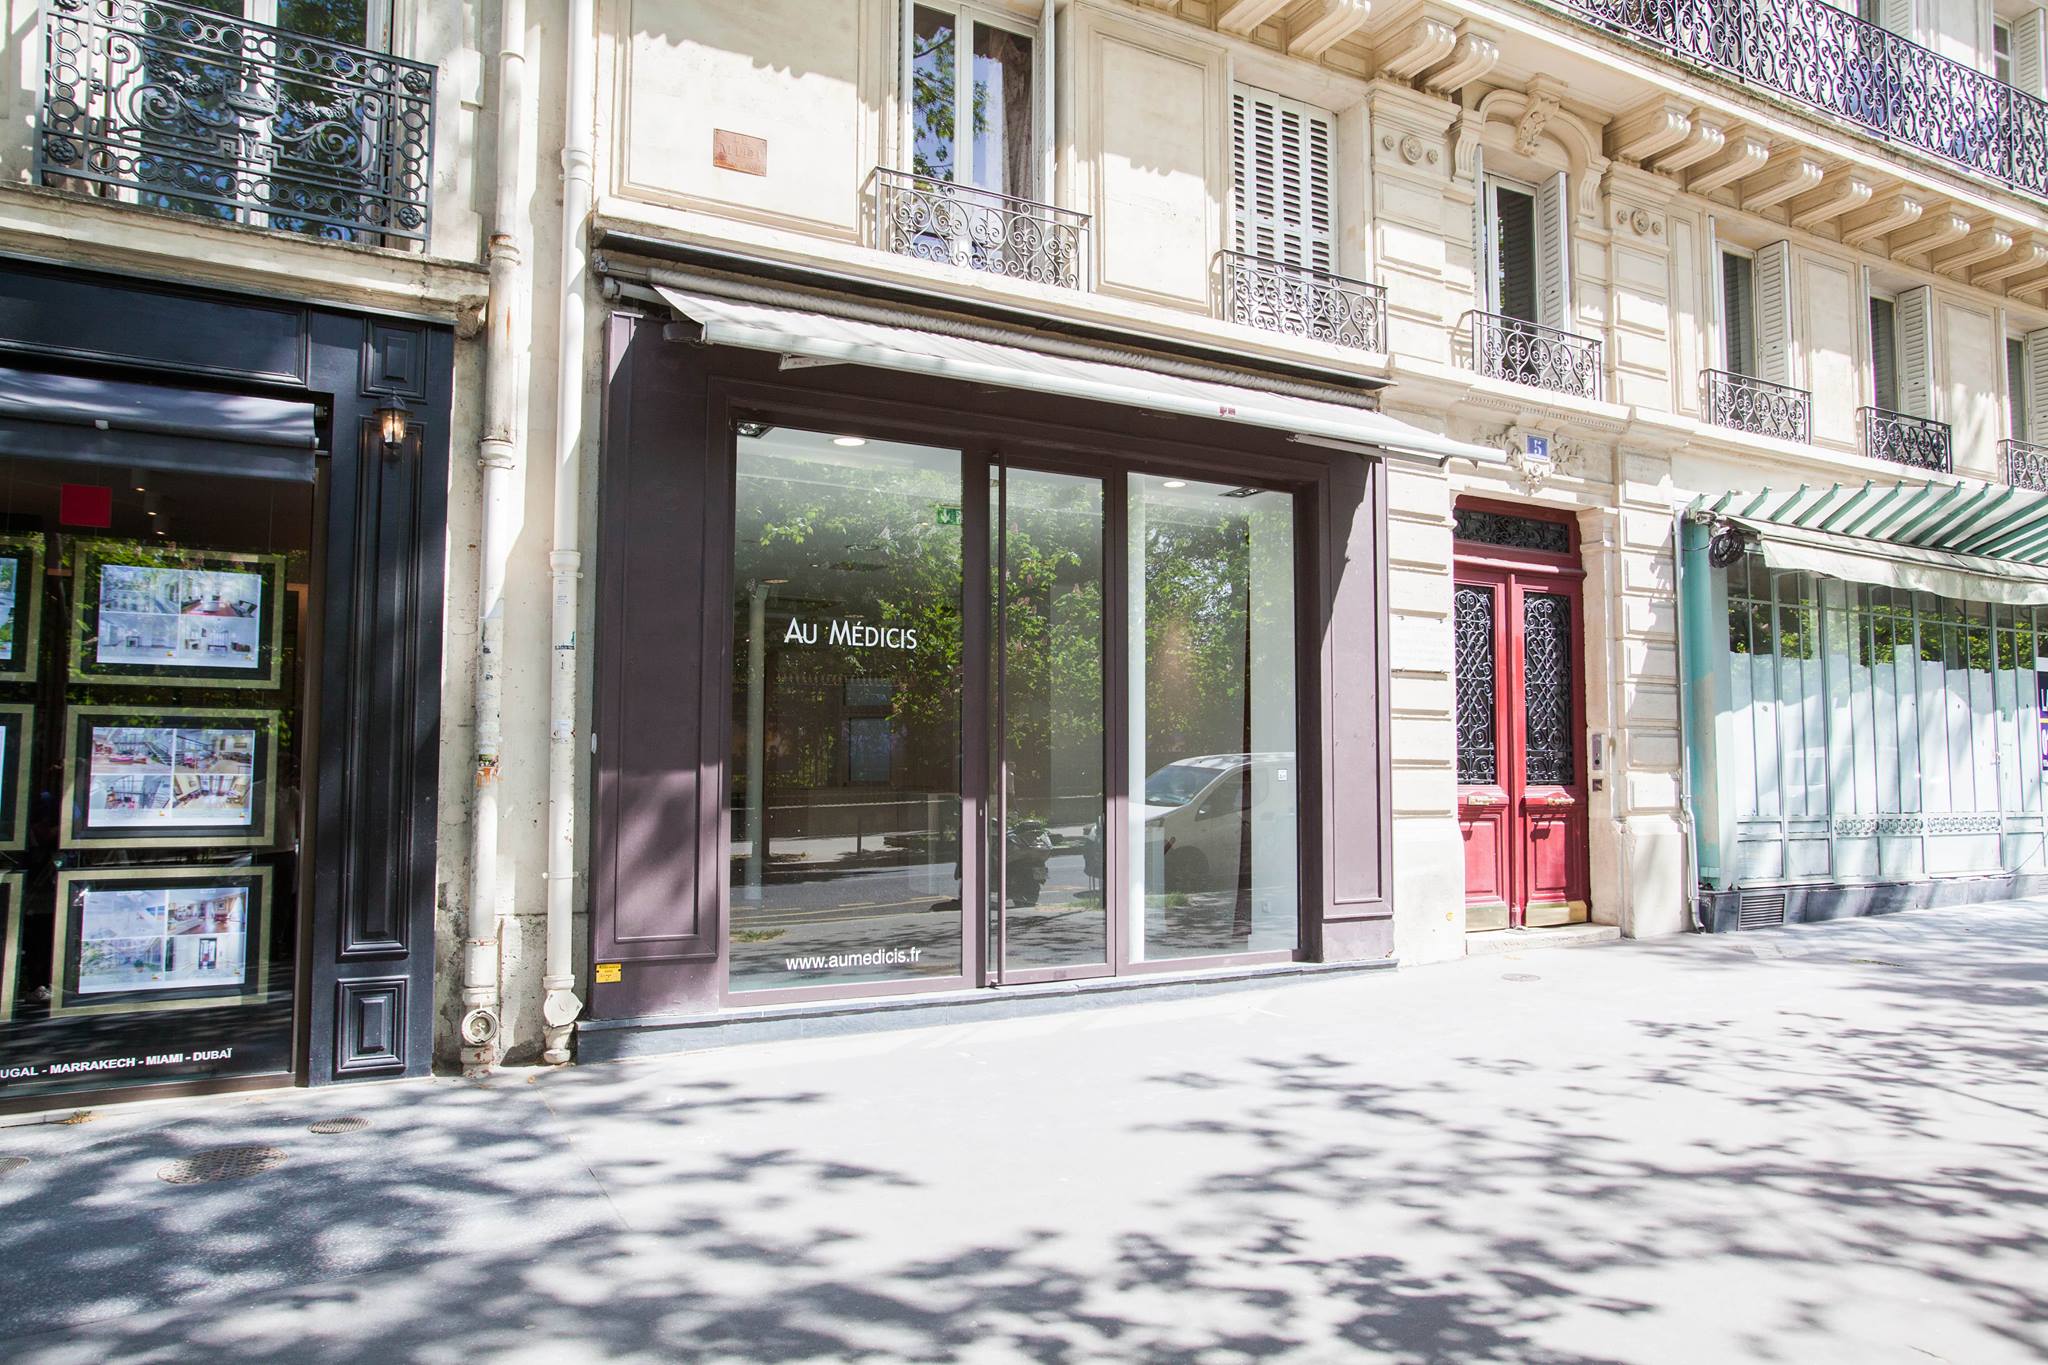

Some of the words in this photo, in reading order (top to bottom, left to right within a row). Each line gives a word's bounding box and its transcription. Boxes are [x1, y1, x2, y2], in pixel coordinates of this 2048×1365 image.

[1534, 439, 1542, 455] 5
[828, 619, 917, 649] MÉDICIS
[785, 946, 922, 971] www.aumedicis.fr
[49, 1057, 136, 1075] MARRAKECH
[146, 1053, 183, 1066] MIAMI
[192, 1047, 232, 1062] DUBAÏ
